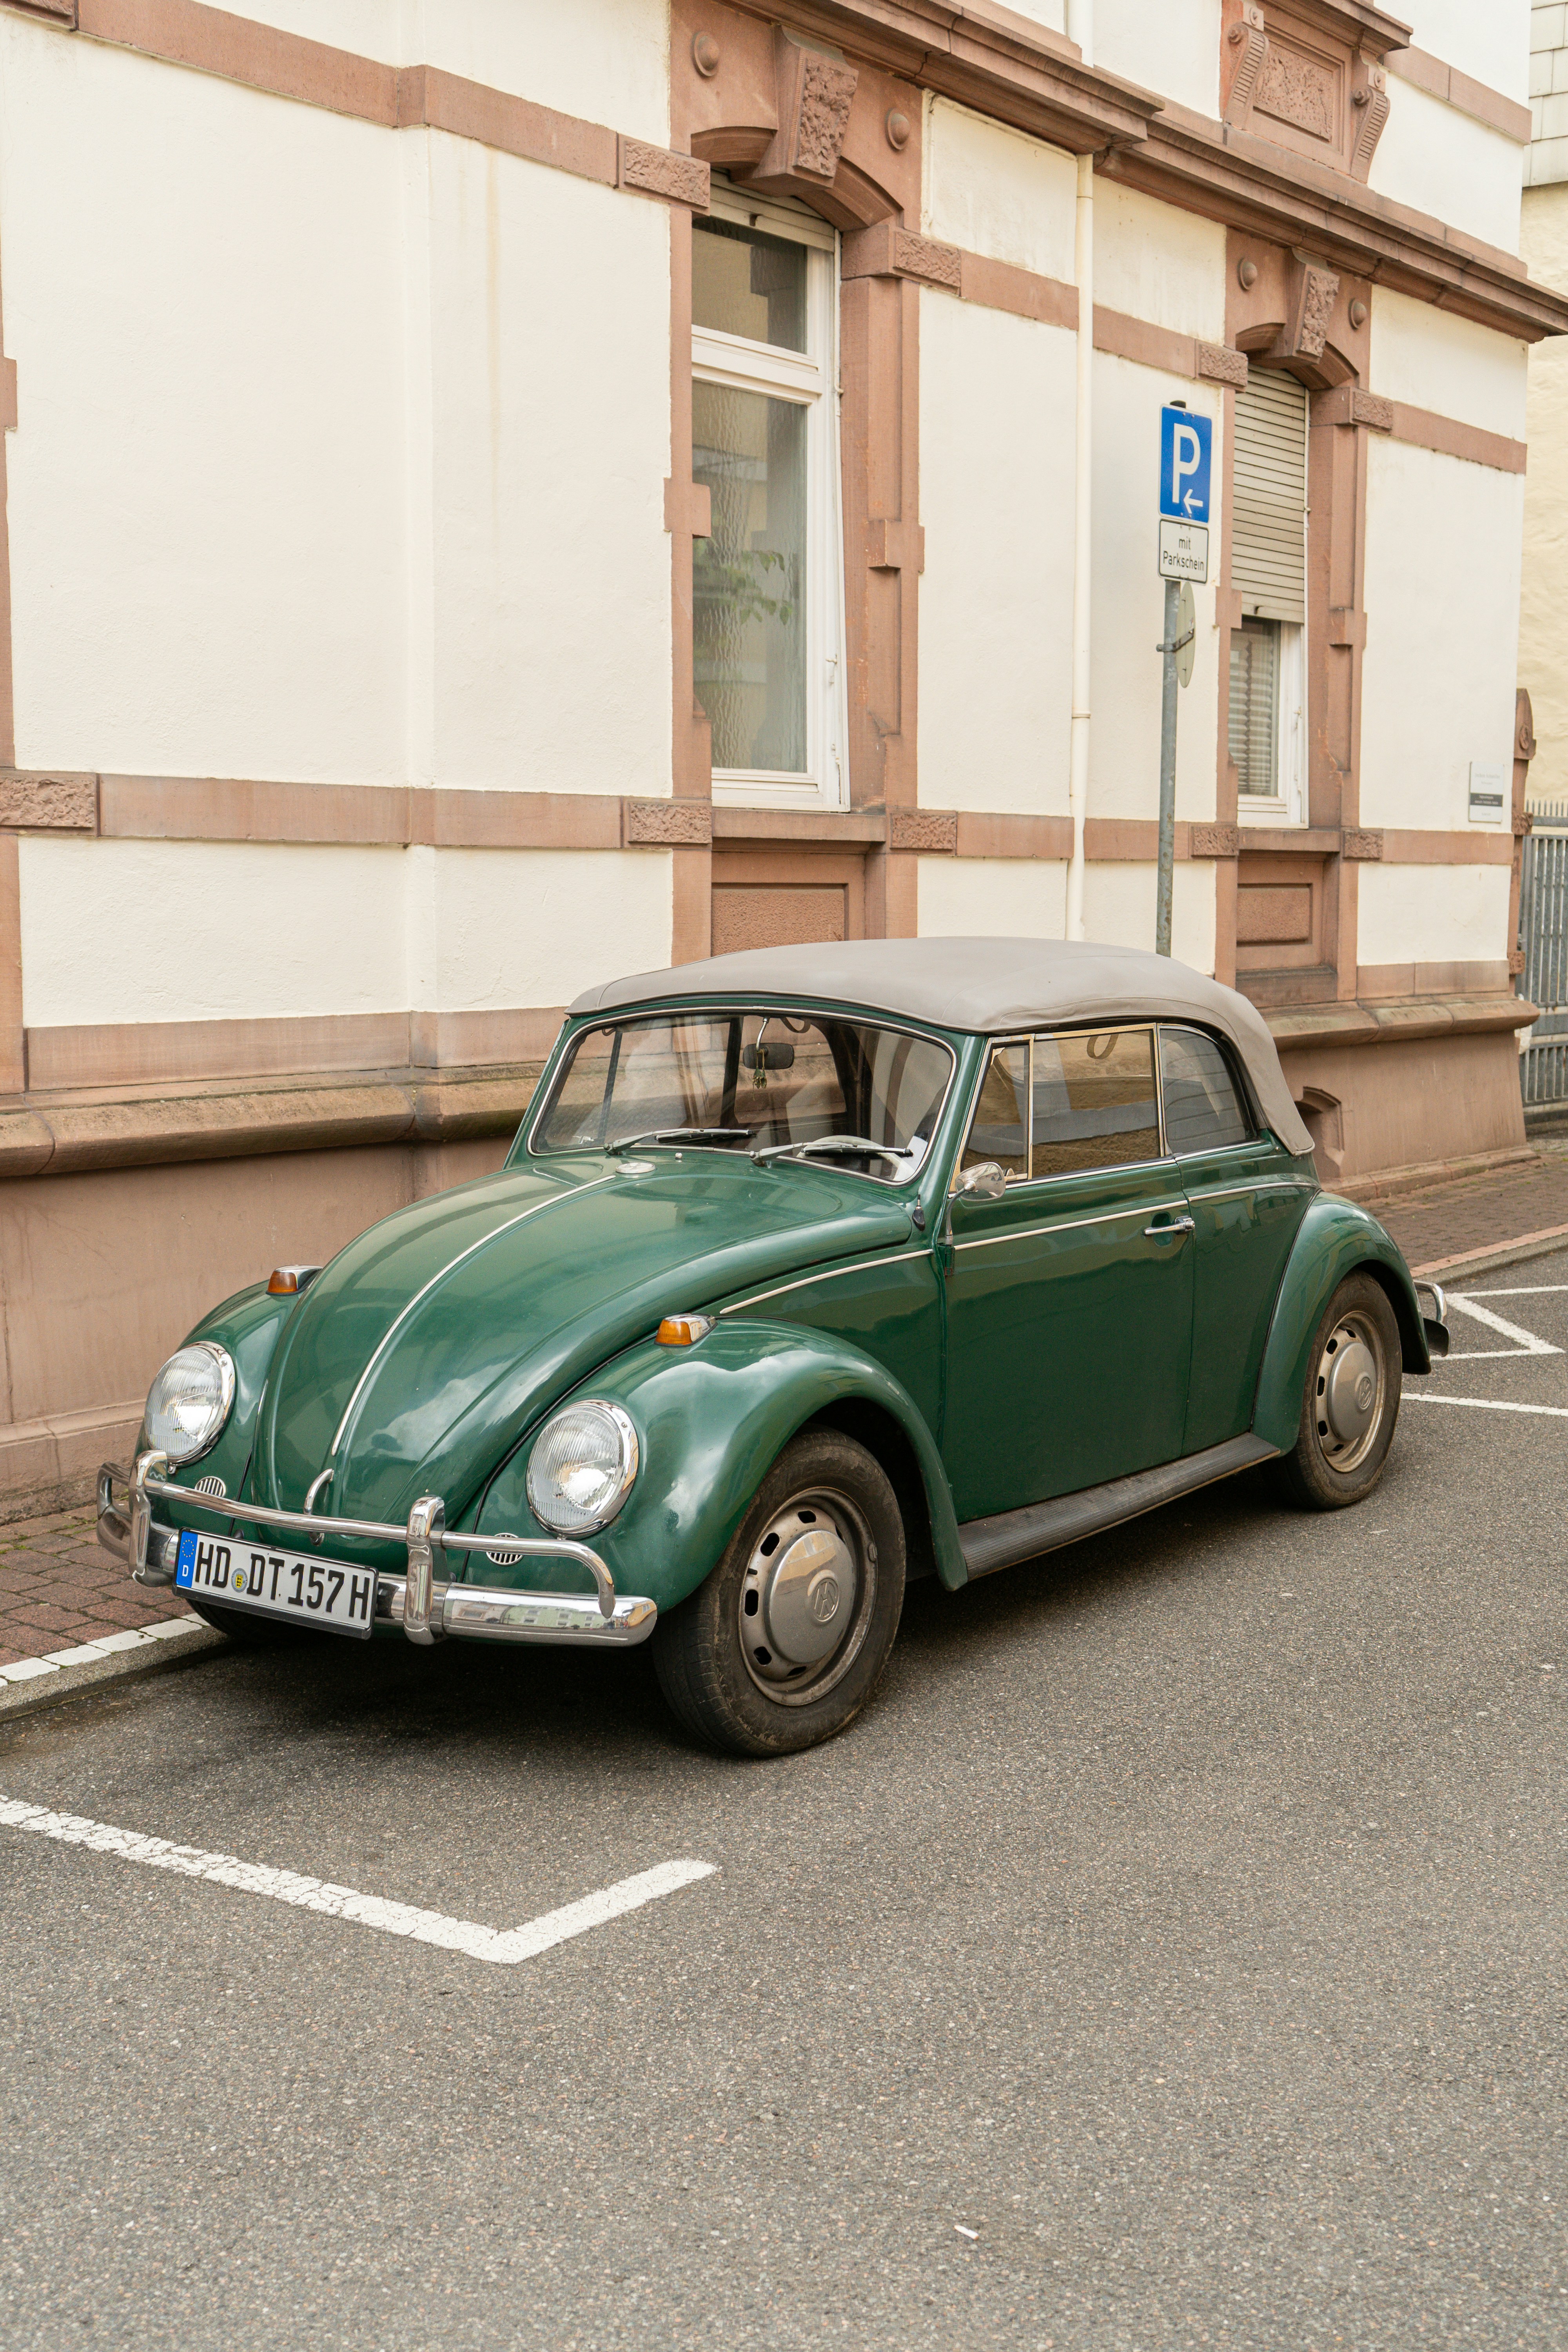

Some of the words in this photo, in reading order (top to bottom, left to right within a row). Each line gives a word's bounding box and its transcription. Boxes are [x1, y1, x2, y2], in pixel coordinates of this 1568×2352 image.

[1172, 423, 1201, 503] P
[1179, 536, 1191, 550] mit
[1163, 550, 1204, 571] Parkschein
[182, 1565, 189, 1577] D
[195, 1542, 231, 1588] HD
